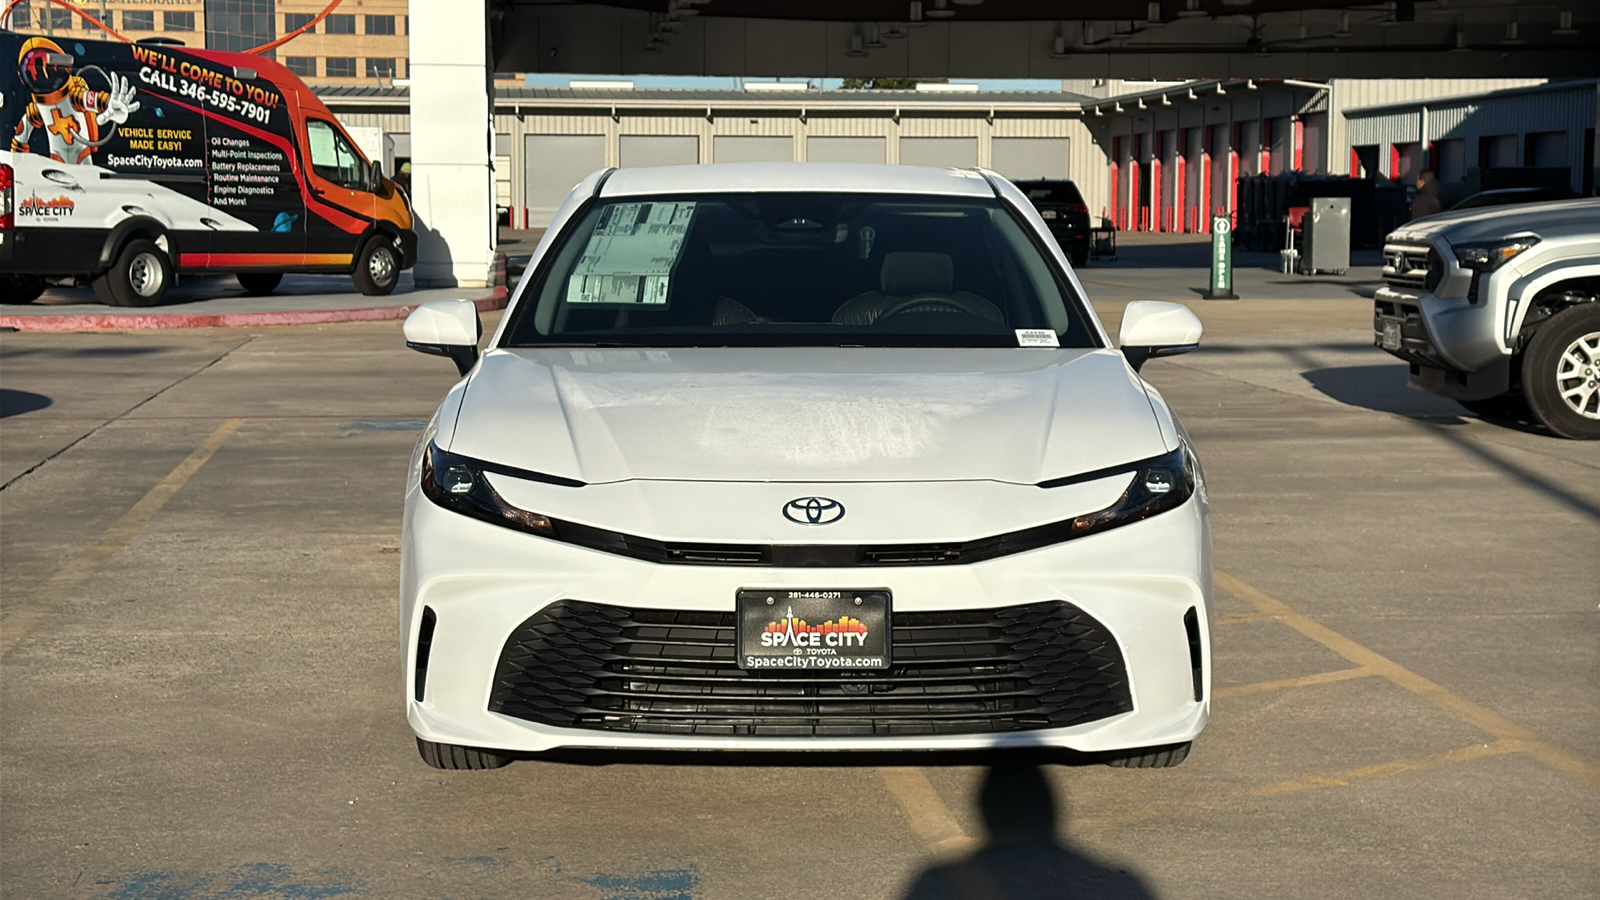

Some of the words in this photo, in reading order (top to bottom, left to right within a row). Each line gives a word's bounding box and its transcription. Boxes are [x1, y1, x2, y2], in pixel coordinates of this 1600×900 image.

[131, 44, 178, 74] WE'LL
[180, 61, 223, 89] COME
[225, 76, 244, 95] TO
[246, 83, 279, 109] YOU!
[139, 66, 178, 93] CALL
[179, 79, 271, 124] 346-595-7901
[118, 127, 154, 138] VEHICLE
[157, 129, 192, 140] SERVICE
[130, 139, 154, 150] MADE
[157, 140, 182, 151] EASY!
[211, 137, 221, 146] Oil
[222, 137, 250, 148] Changes
[211, 149, 247, 159] Multi-Point
[248, 150, 283, 160] Inspections
[107, 153, 203, 169] SpaceCityToyota.com
[212, 161, 236, 172] Battery
[237, 162, 280, 172] Replacements
[213, 173, 239, 182] Routine
[240, 174, 279, 183] Maintenance
[214, 185, 237, 195] Engine
[237, 185, 274, 195] Diagnostics
[213, 197, 228, 206] And
[228, 197, 247, 206] More!
[52, 206, 74, 216] CITY
[1217, 261, 1226, 289] OPEN
[788, 591, 841, 599] 281-446-0271
[825, 631, 868, 647] CITY
[806, 648, 837, 656] TOYOTA
[747, 656, 882, 669] SpaceCityToyota.com
